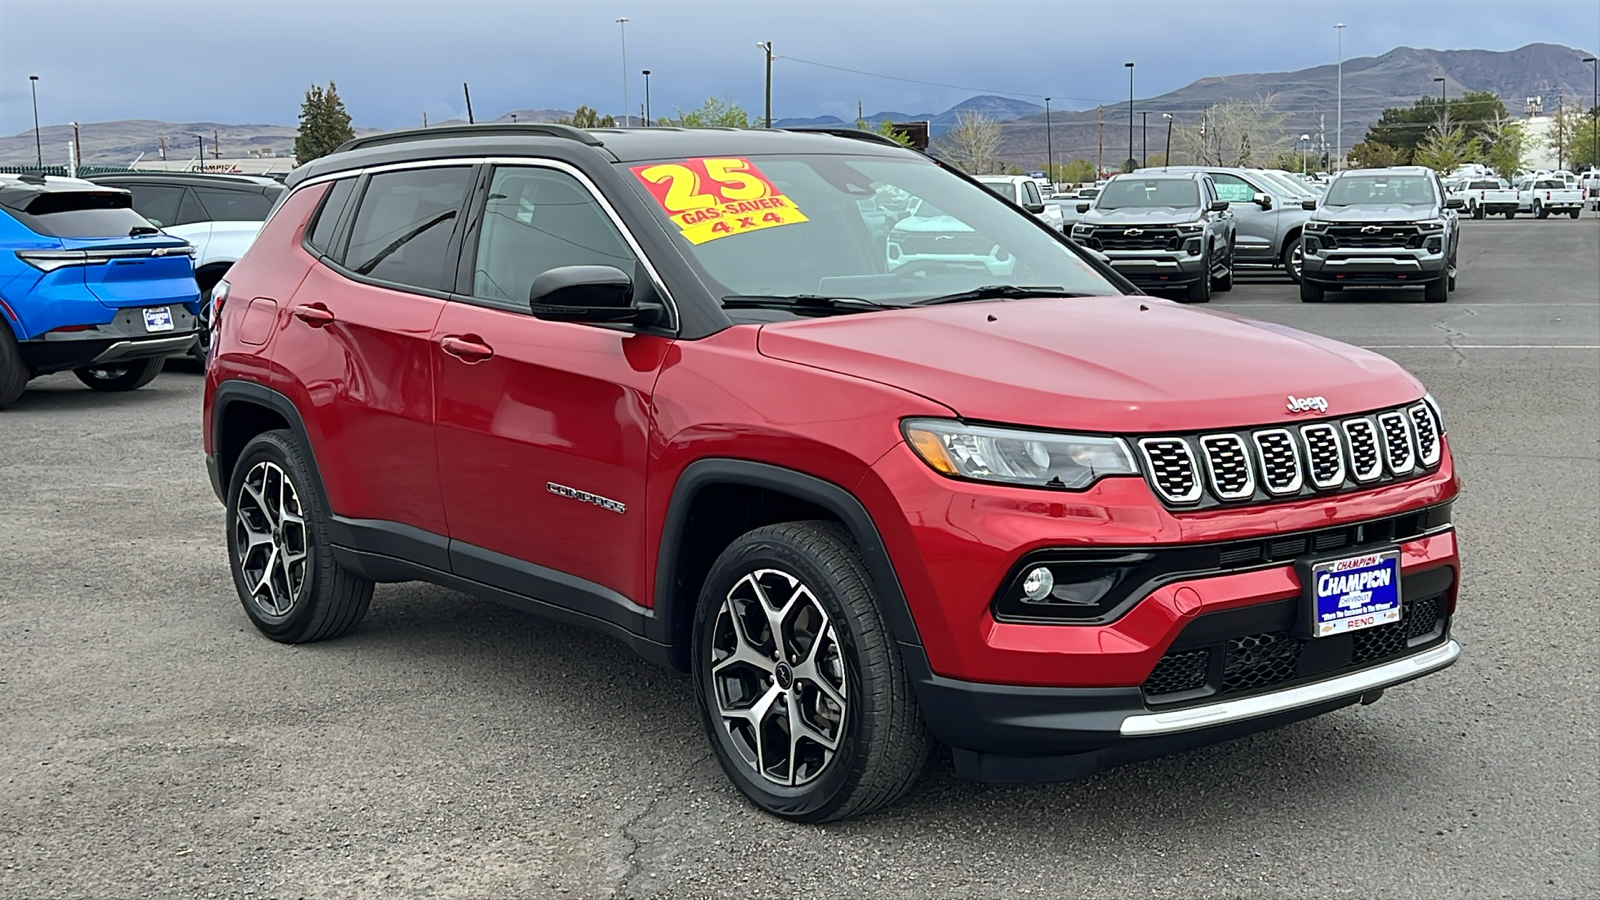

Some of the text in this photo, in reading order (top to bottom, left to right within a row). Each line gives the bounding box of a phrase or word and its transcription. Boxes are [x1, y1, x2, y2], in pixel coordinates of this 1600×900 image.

[640, 158, 772, 213] 25
[681, 197, 786, 226] GAS-SAVER
[1286, 395, 1329, 413] Jeep
[546, 481, 626, 515] COMPASS
[1336, 556, 1378, 571] CHAMPION
[1318, 568, 1391, 598] CHAMPION
[1341, 594, 1369, 604] CHEVROLET
[1347, 616, 1374, 629] RENO
